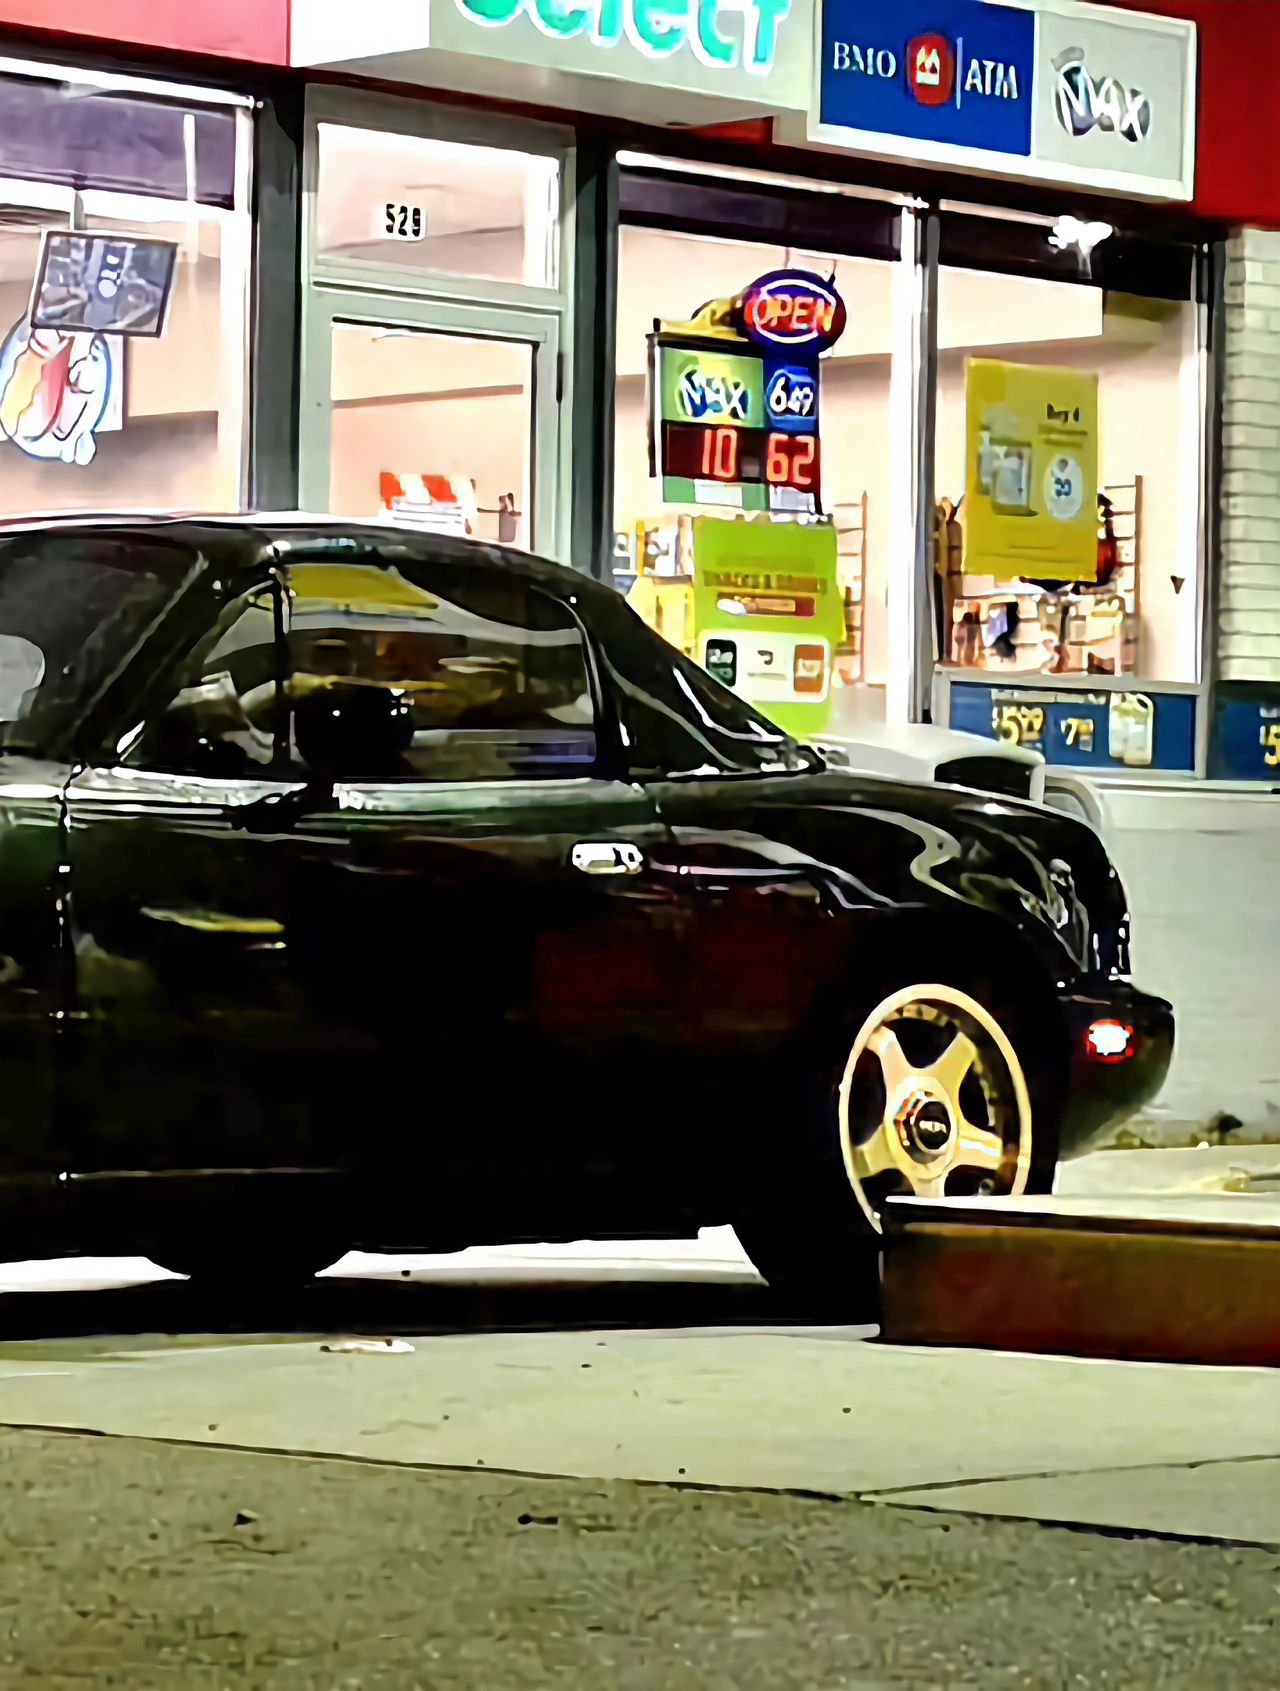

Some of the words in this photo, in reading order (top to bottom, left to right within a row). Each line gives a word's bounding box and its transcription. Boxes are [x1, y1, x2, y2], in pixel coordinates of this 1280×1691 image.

[833, 41, 897, 78] BMO
[964, 58, 1019, 99] ATM
[385, 203, 421, 237] 529
[745, 292, 837, 332] OPEN
